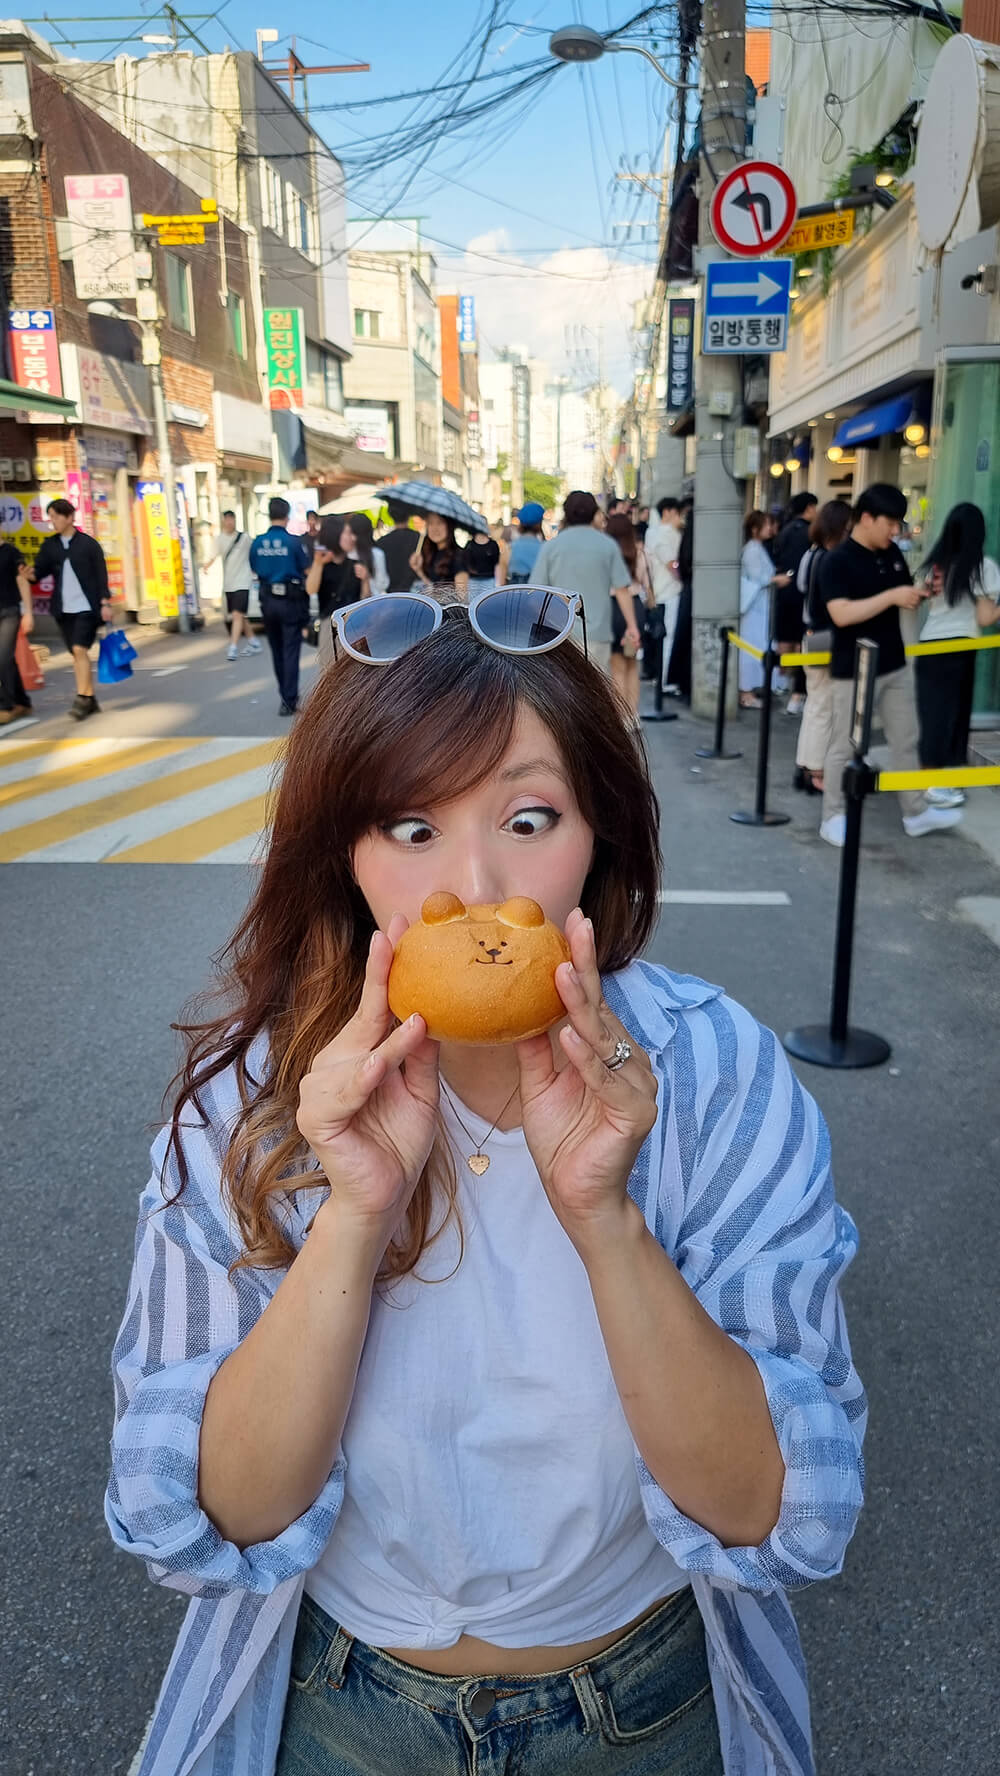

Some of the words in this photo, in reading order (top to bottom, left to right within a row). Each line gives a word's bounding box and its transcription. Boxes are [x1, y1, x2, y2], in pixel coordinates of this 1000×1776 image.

[780, 228, 810, 249] CTV
[10, 311, 50, 329] 성수
[710, 318, 781, 347] 일방통행
